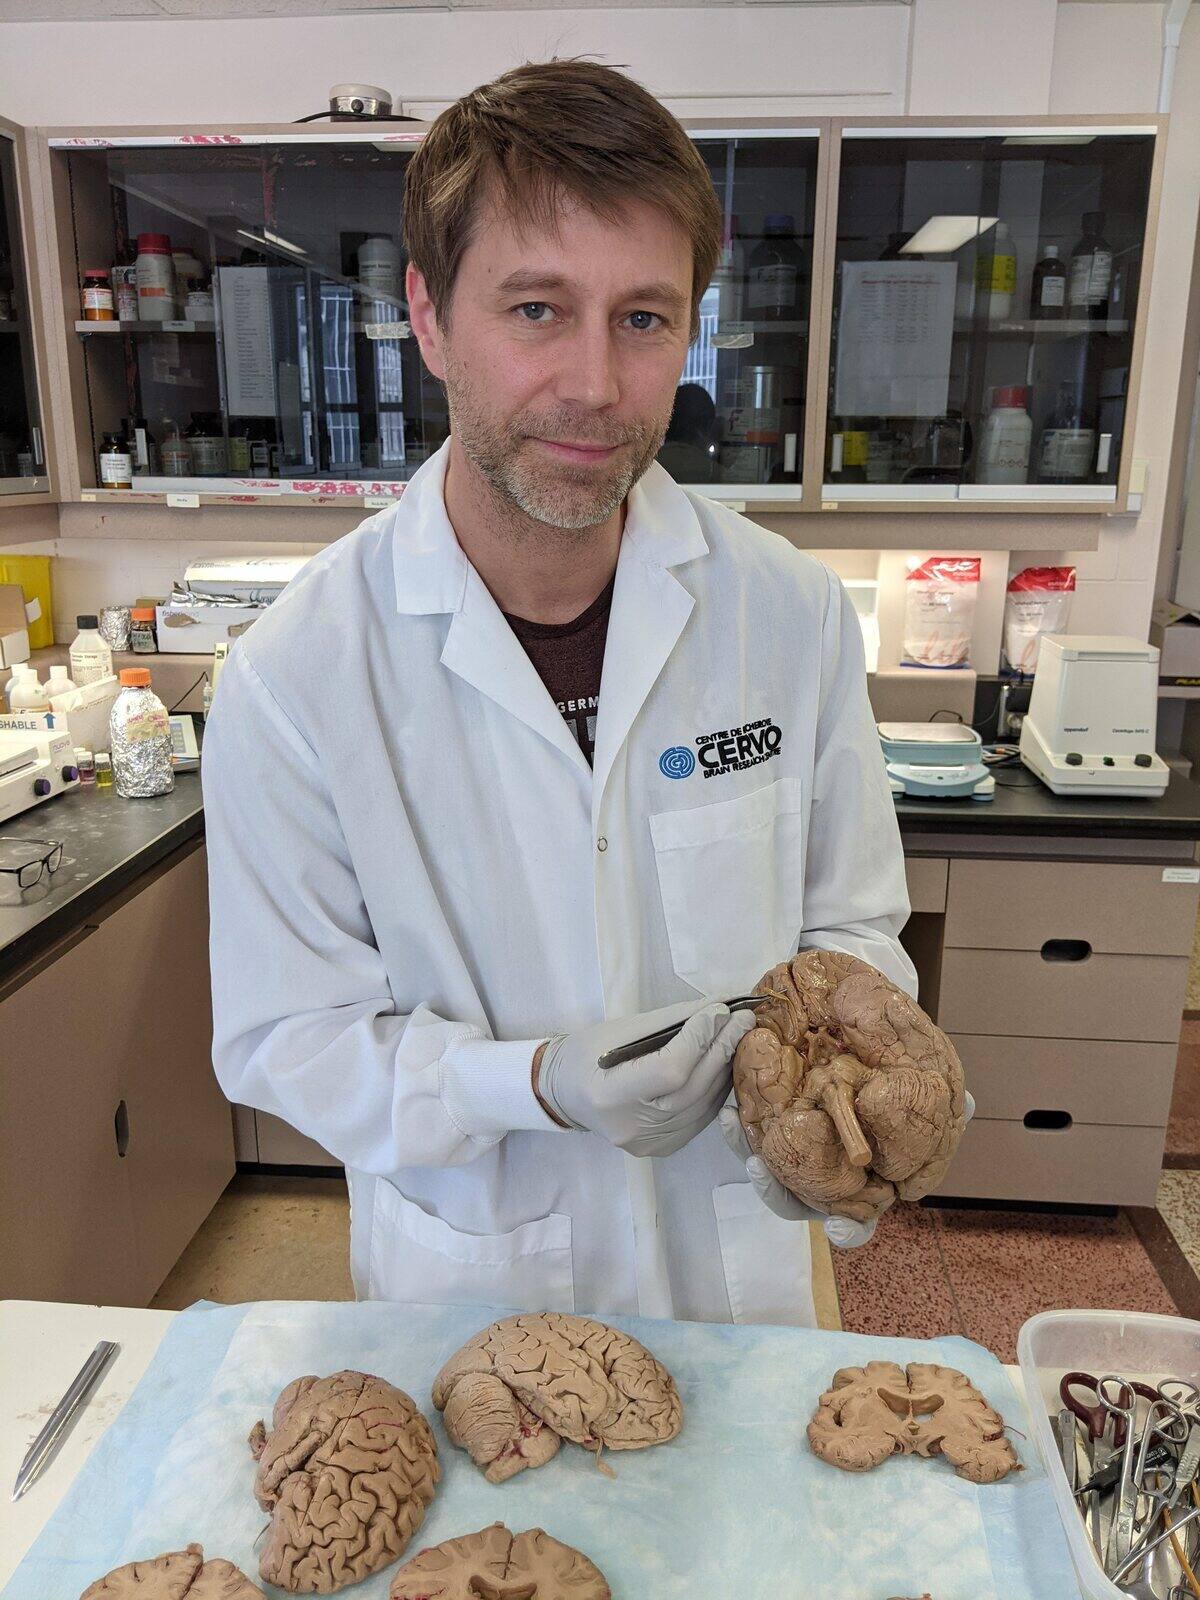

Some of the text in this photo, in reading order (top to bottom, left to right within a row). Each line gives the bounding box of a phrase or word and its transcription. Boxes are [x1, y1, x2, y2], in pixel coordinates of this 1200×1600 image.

[695, 730, 729, 745] CENTRE
[730, 727, 742, 737] DE
[698, 725, 782, 769] CERVO
[703, 765, 730, 779] BRAIN
